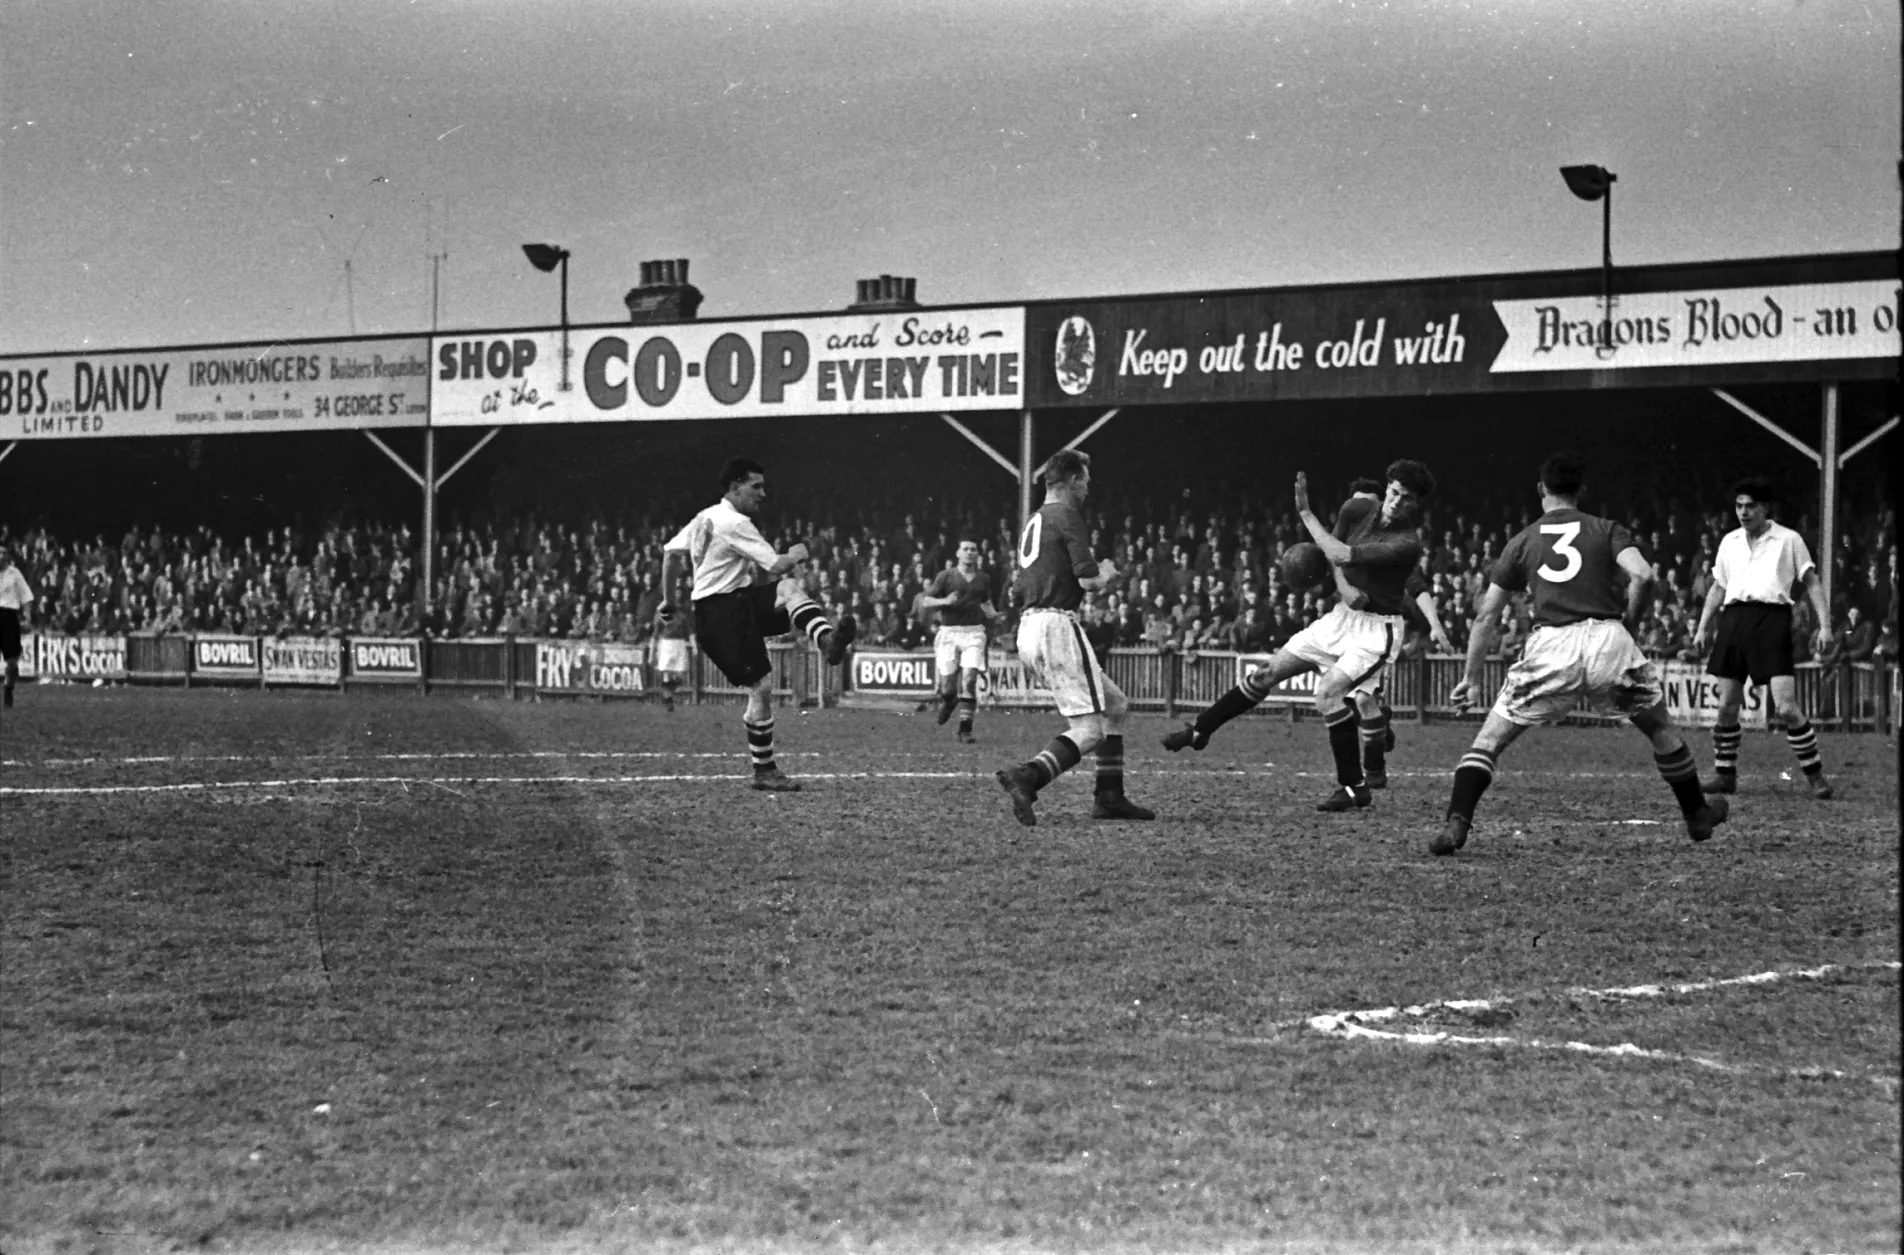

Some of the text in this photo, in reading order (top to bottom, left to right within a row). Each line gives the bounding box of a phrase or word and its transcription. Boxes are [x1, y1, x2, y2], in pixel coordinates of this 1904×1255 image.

[826, 322, 881, 350] and
[894, 317, 972, 347] Score
[1532, 305, 1671, 361] Dragons
[1682, 294, 1783, 351] Blood
[1813, 306, 1857, 336] an
[439, 339, 537, 381] SHOP
[1118, 313, 1466, 389] Keep out the cold with
[189, 355, 320, 387] IRONMONGERS
[583, 329, 810, 410] CO-OP
[817, 352, 1019, 401] EVERY TIME
[74, 361, 169, 412] DANDY
[481, 390, 501, 414] at
[510, 378, 541, 406] the
[314, 395, 330, 418] 34
[334, 393, 384, 416] GEORGE
[23, 415, 103, 433] LIMITED
[1536, 520, 1583, 583] 3
[81, 650, 123, 675] COCOA
[200, 642, 254, 665] BOVRIL
[357, 644, 416, 669] BOVRIL
[590, 664, 643, 691] COCOA
[860, 660, 933, 685] BOVRIL
